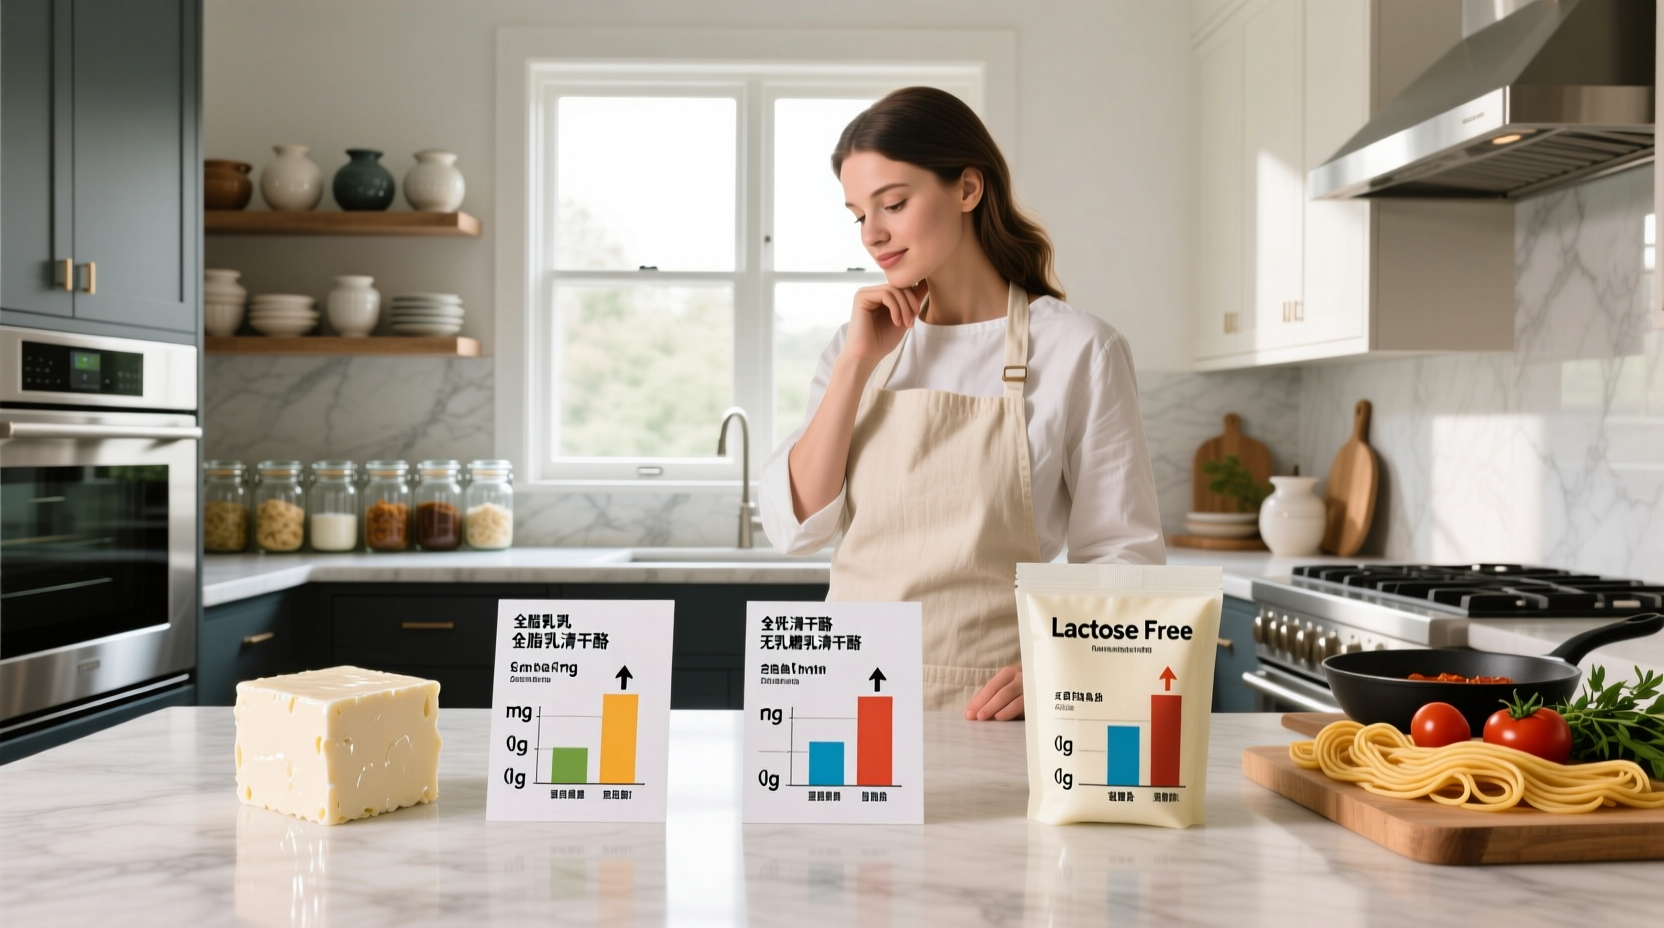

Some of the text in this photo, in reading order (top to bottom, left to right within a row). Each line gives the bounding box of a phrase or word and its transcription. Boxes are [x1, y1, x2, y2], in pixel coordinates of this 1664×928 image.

[1052, 617, 1193, 641] Lactose Free
[506, 706, 532, 722] mg
[760, 708, 782, 725] ng
